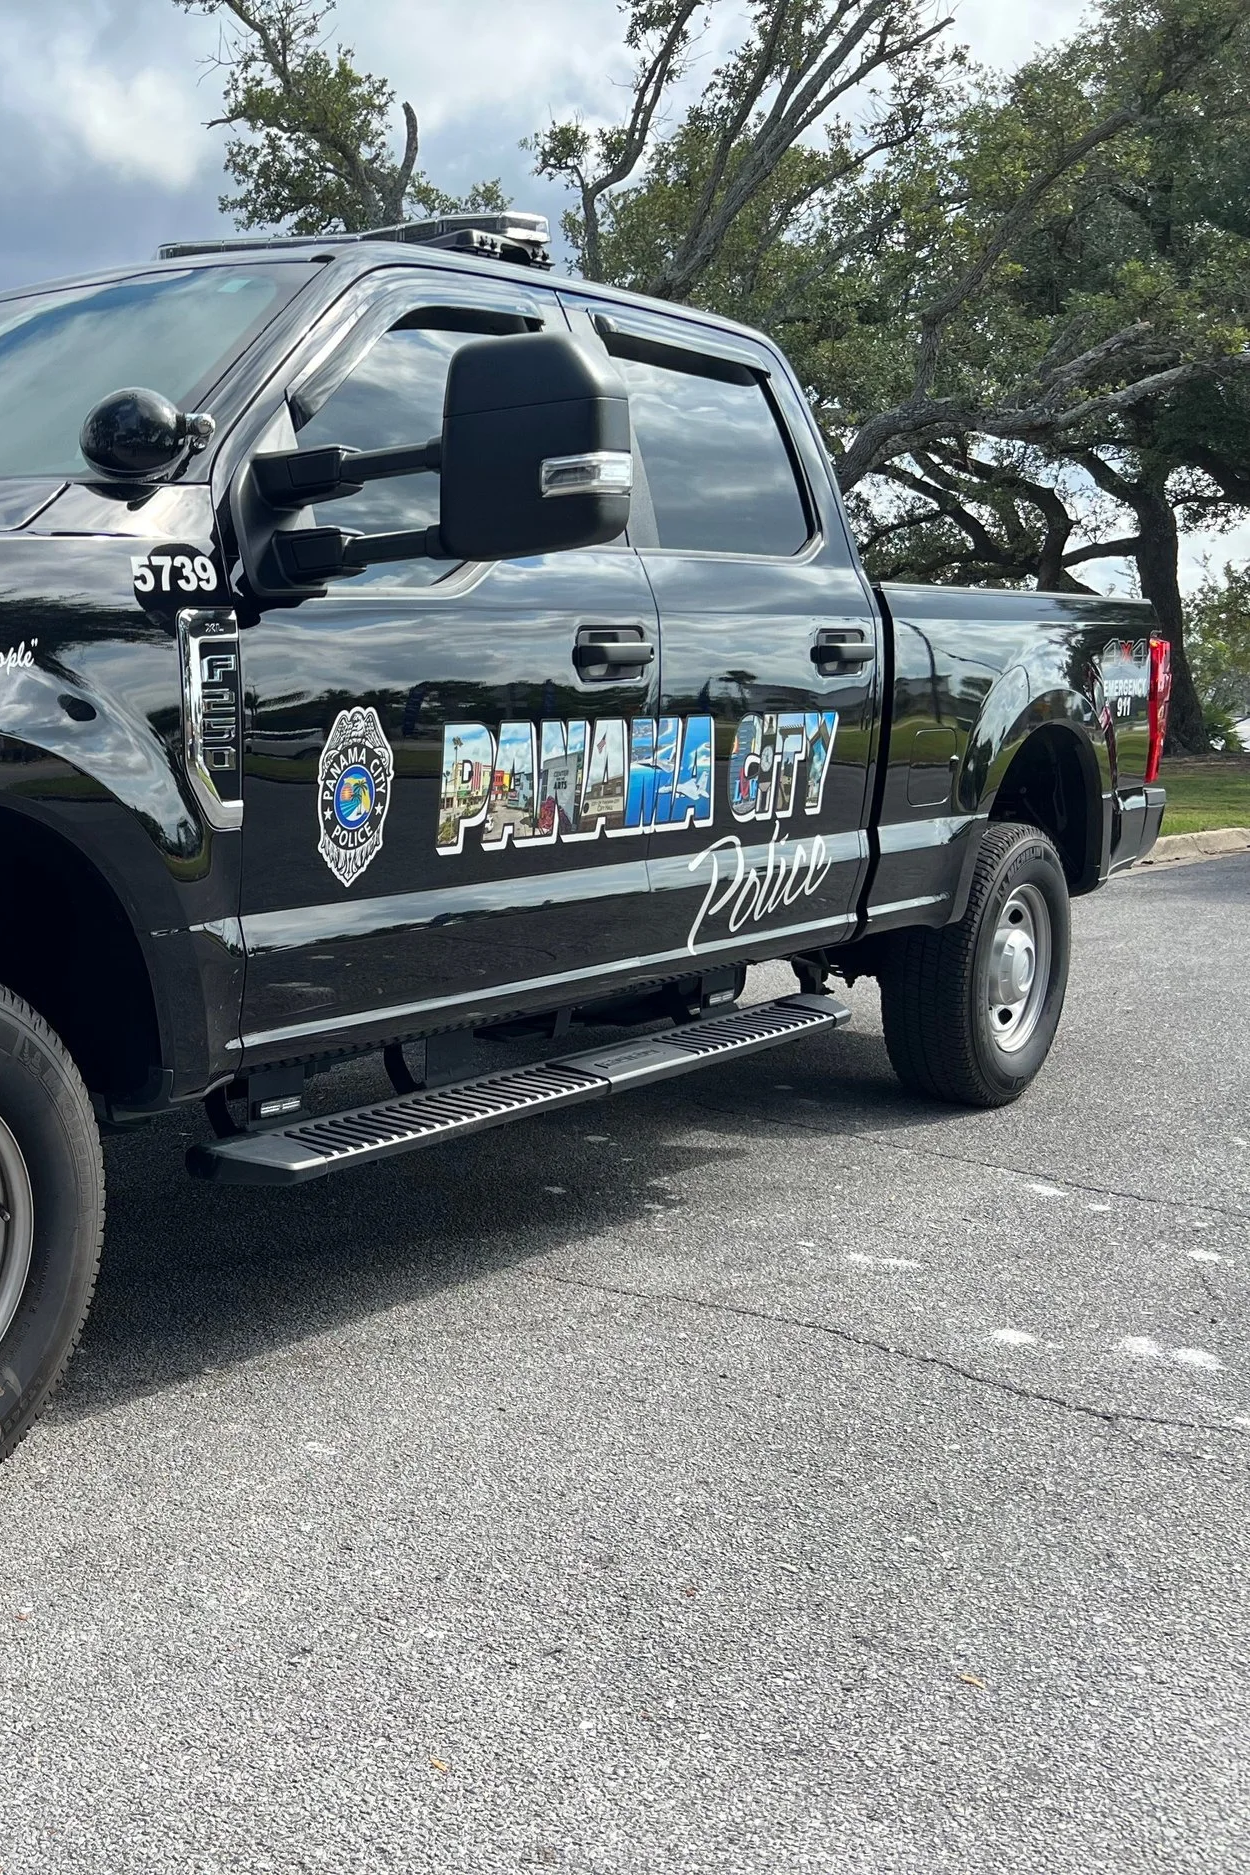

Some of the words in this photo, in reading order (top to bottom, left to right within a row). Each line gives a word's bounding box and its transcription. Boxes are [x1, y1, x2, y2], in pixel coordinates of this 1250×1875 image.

[130, 555, 217, 592] 5739
[205, 623, 225, 633] XL
[1104, 679, 1148, 697] EMERGENCY
[1117, 697, 1131, 717] 911
[323, 747, 367, 800] PANAMA
[369, 758, 386, 793] CITY
[435, 713, 715, 856] PANAMA
[727, 711, 839, 823] CITY
[331, 821, 373, 847] POLICE
[1006, 846, 1041, 881] MICHELIN
[688, 821, 832, 956] Police
